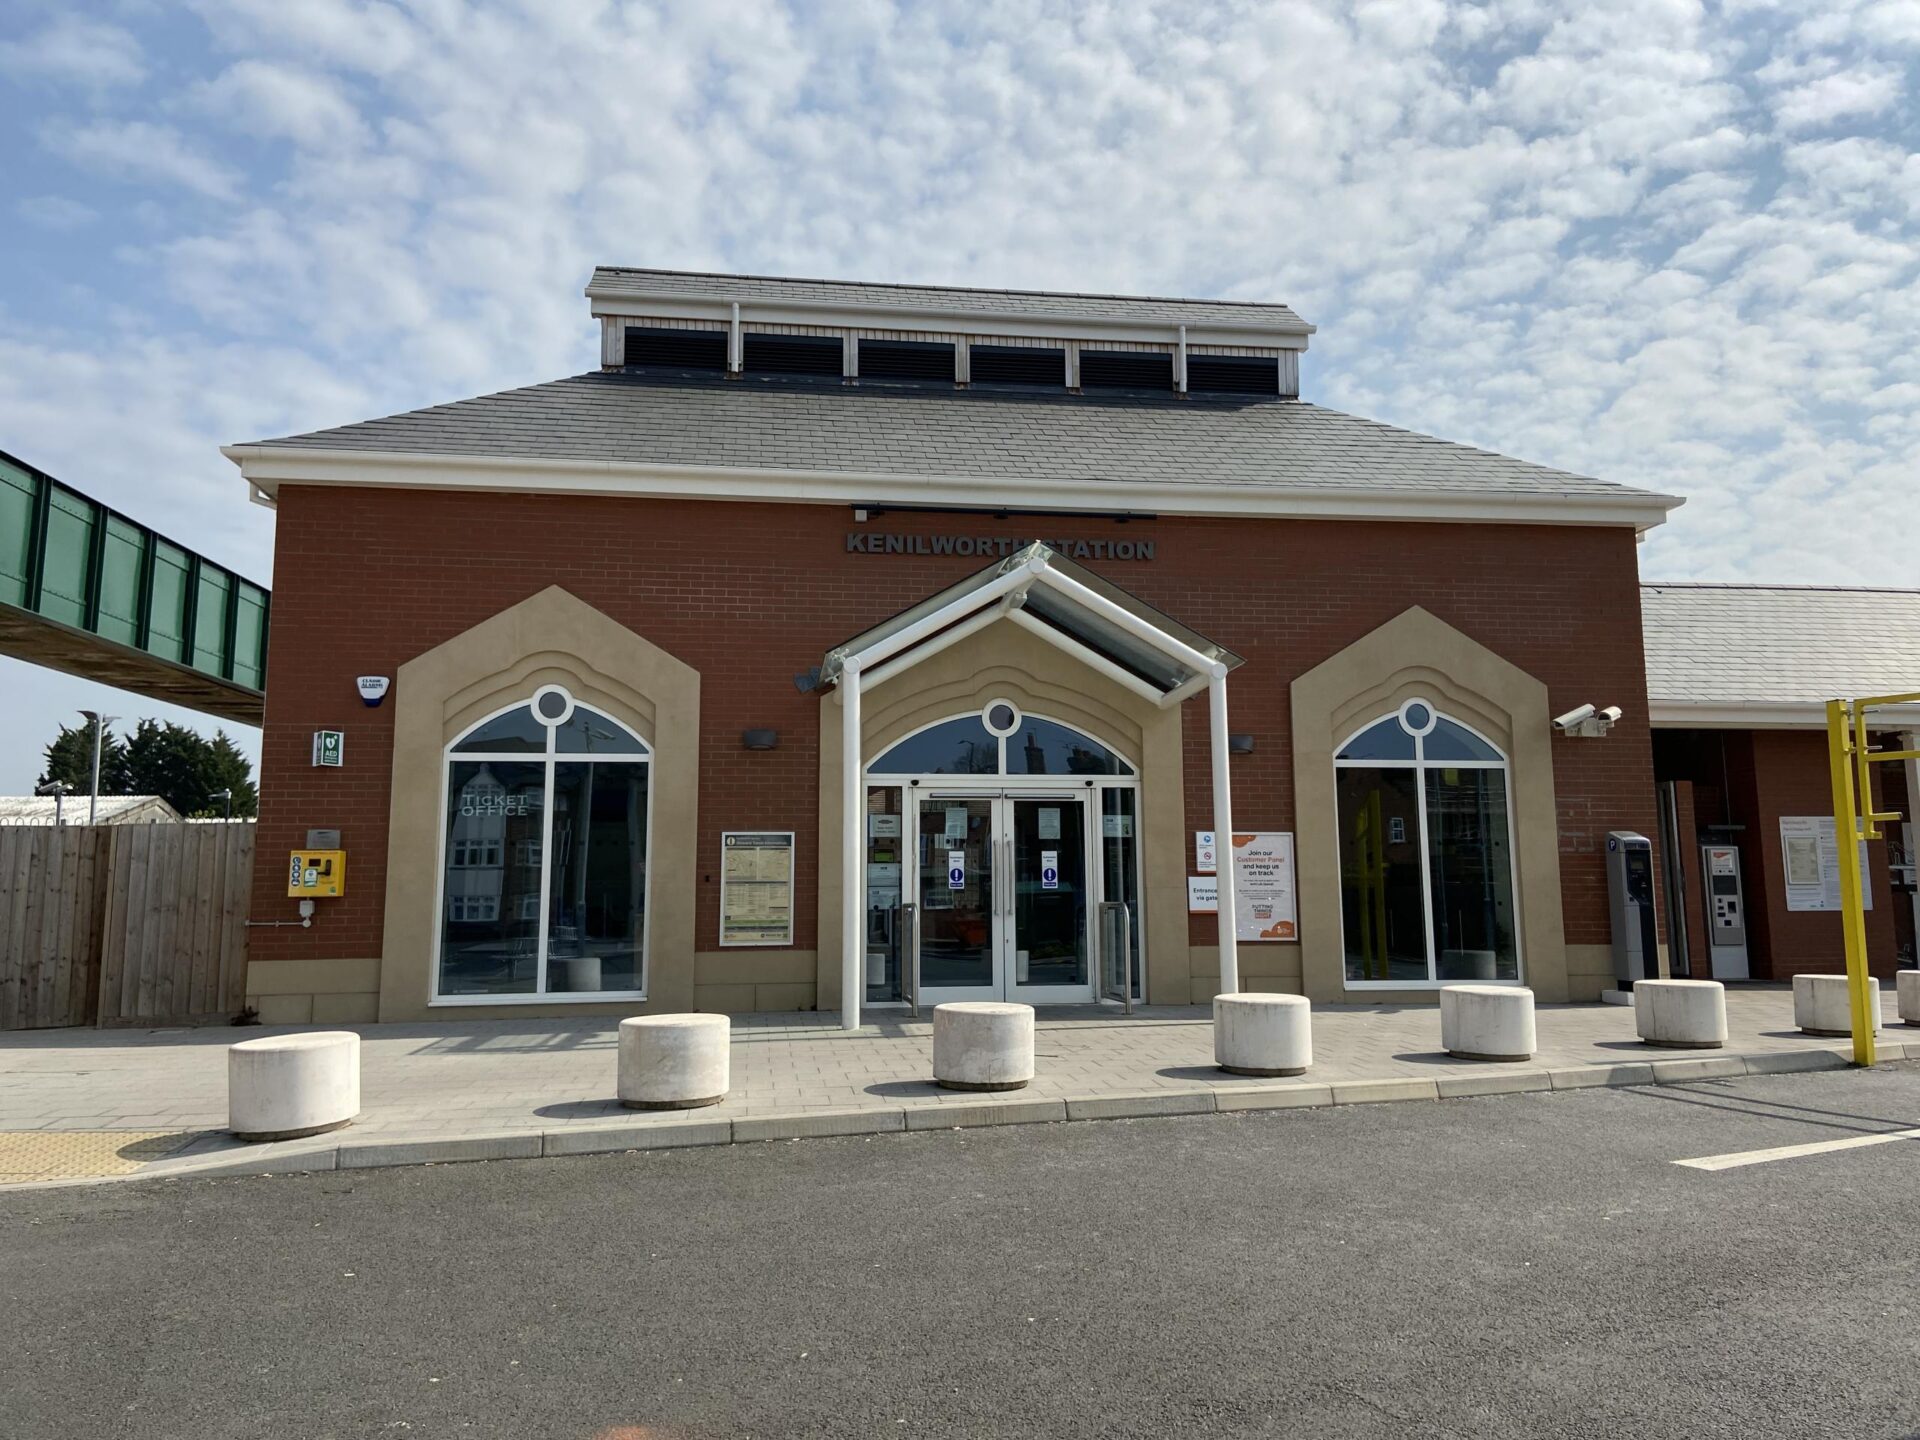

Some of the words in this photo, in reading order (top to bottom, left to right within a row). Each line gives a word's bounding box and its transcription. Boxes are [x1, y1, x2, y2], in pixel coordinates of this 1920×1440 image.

[846, 533, 1031, 557] KENILWORTH
[462, 794, 528, 806] TICKET
[461, 805, 528, 816] OFFICE
